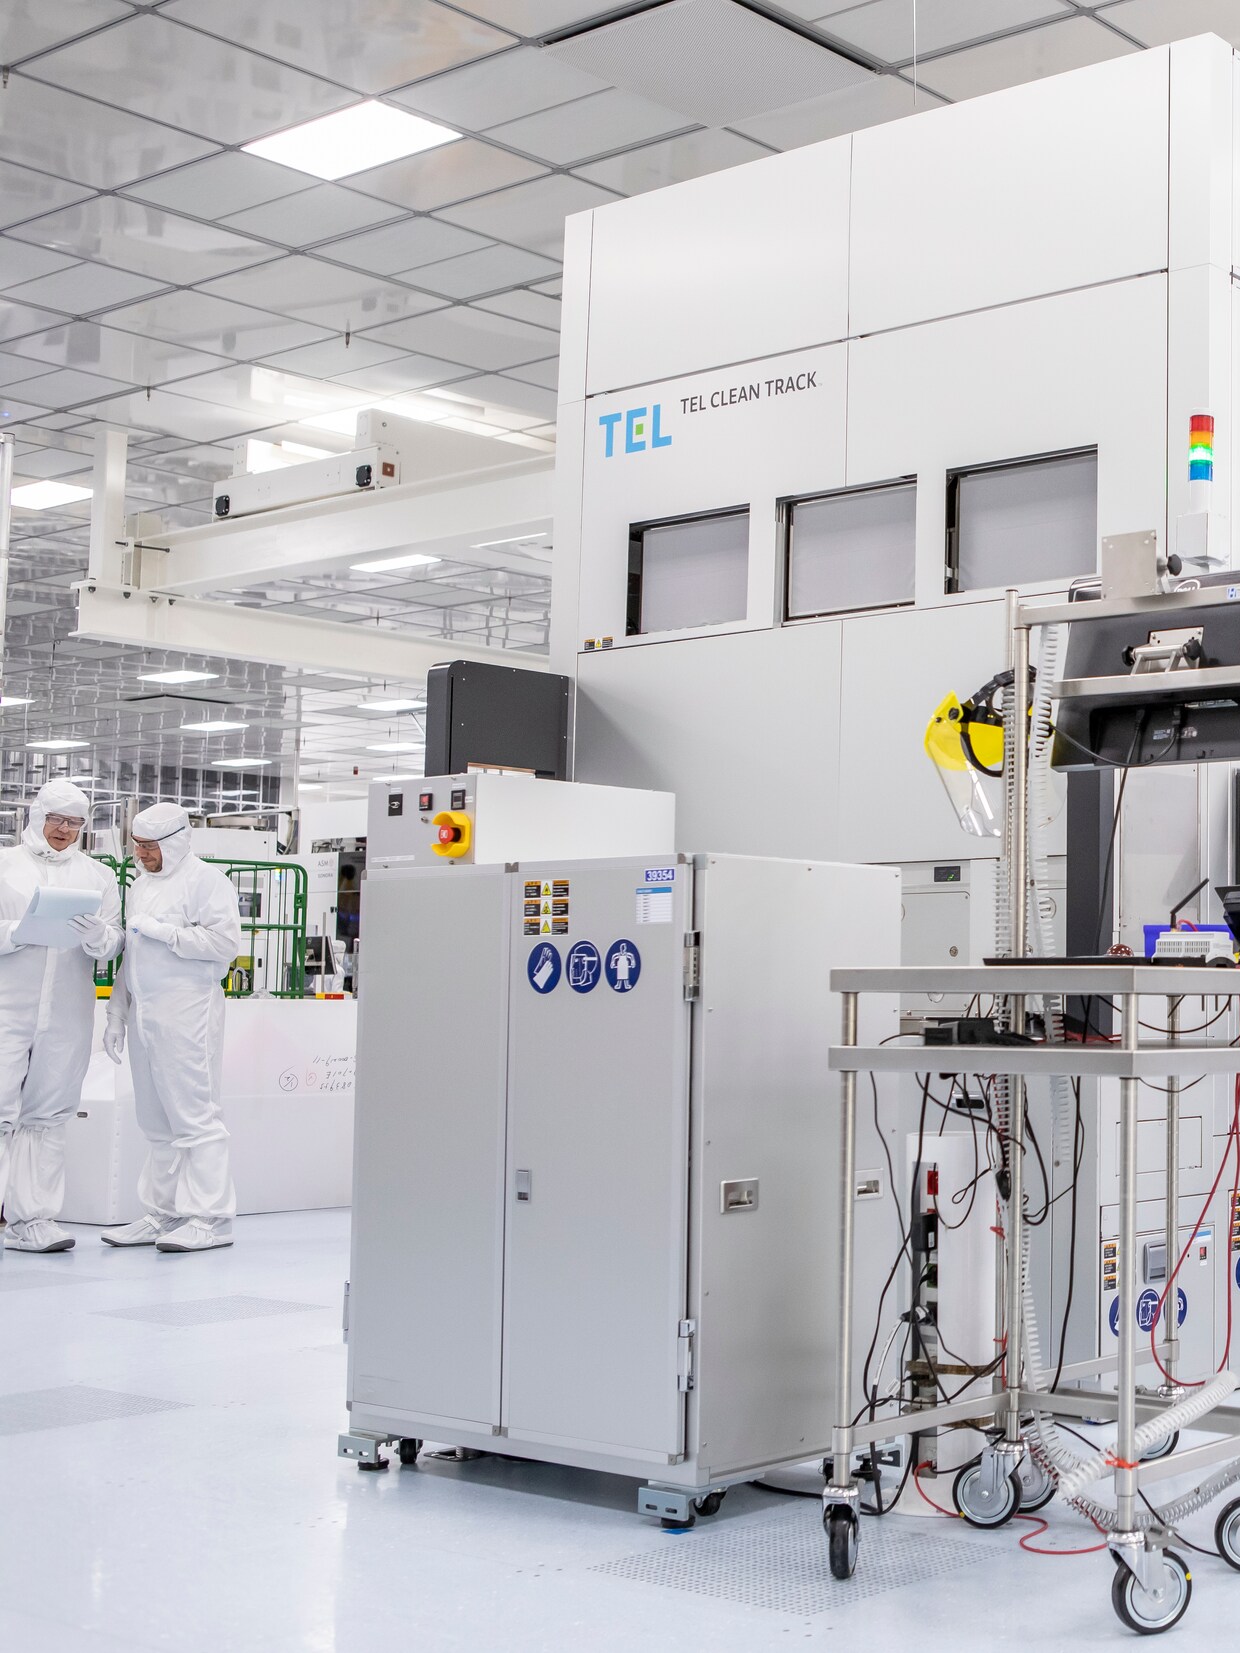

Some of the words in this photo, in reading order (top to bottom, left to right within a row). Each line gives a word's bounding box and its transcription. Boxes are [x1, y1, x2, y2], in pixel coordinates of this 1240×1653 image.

[680, 394, 707, 414] TEL
[710, 383, 760, 408] CLEAN
[765, 371, 817, 396] TRACK
[599, 404, 672, 458] TEL
[647, 869, 673, 881] 39354
